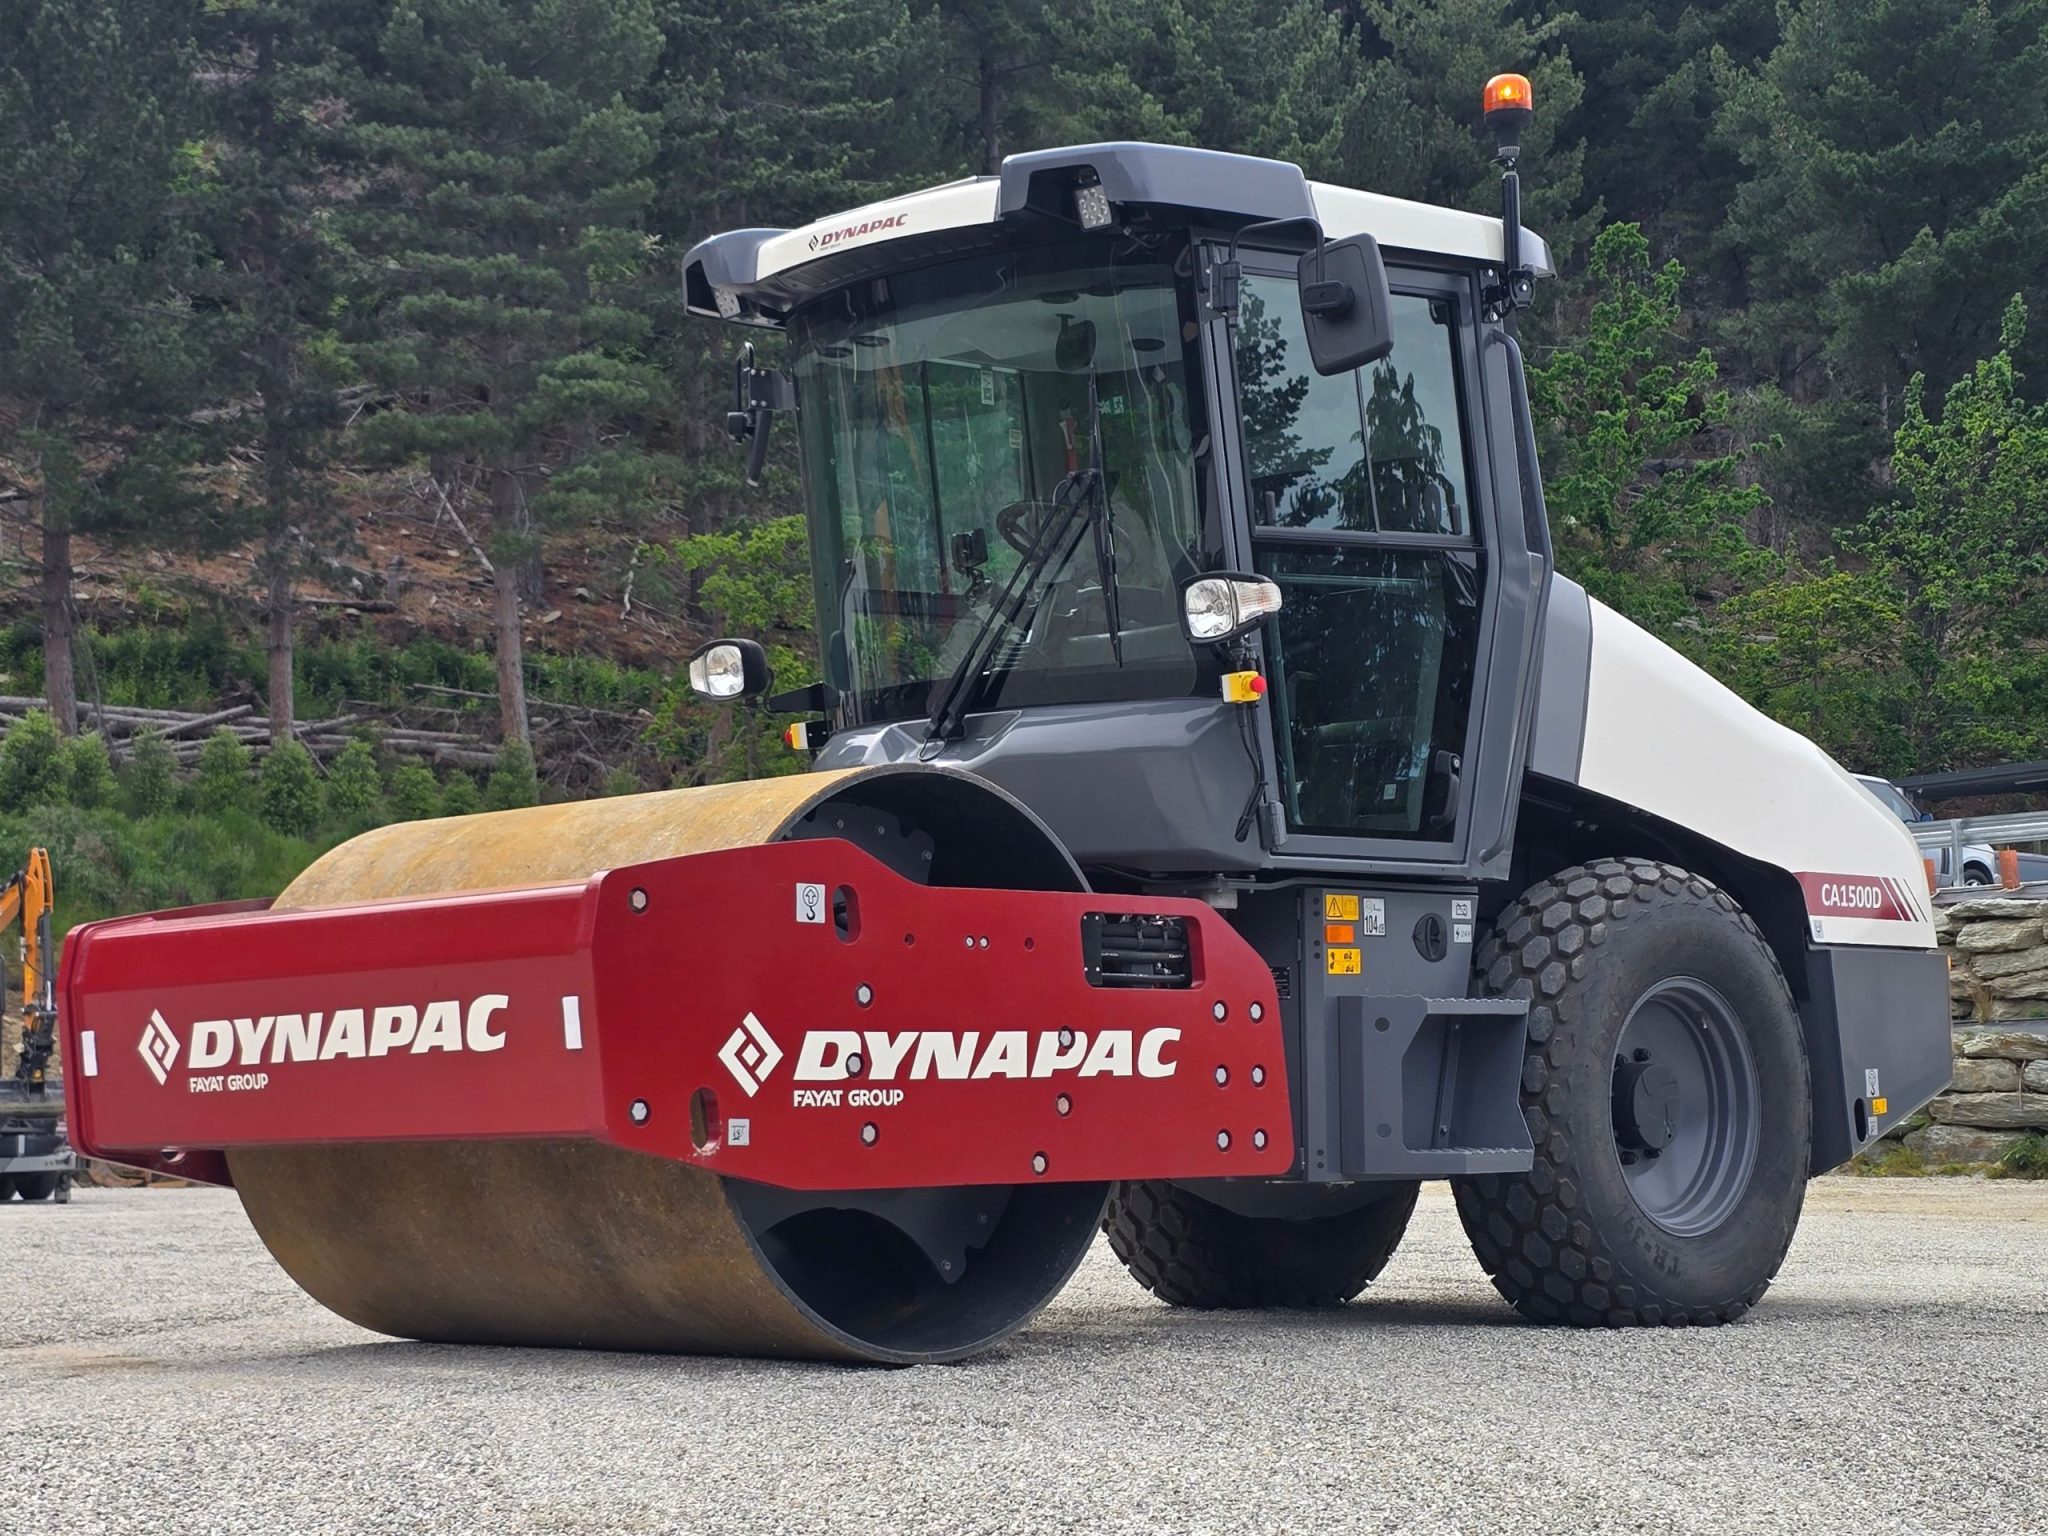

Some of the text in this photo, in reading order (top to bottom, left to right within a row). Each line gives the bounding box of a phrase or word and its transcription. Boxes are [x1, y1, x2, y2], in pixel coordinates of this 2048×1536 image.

[820, 213, 908, 246] DYNAPAC
[1821, 883, 1882, 909] CA1500D
[188, 994, 509, 1069] DYNAPAC
[792, 1027, 1182, 1080] DYNAPAC
[189, 1073, 269, 1093] FAYAT GROUP
[793, 1088, 904, 1107] FAYAT GROUP
